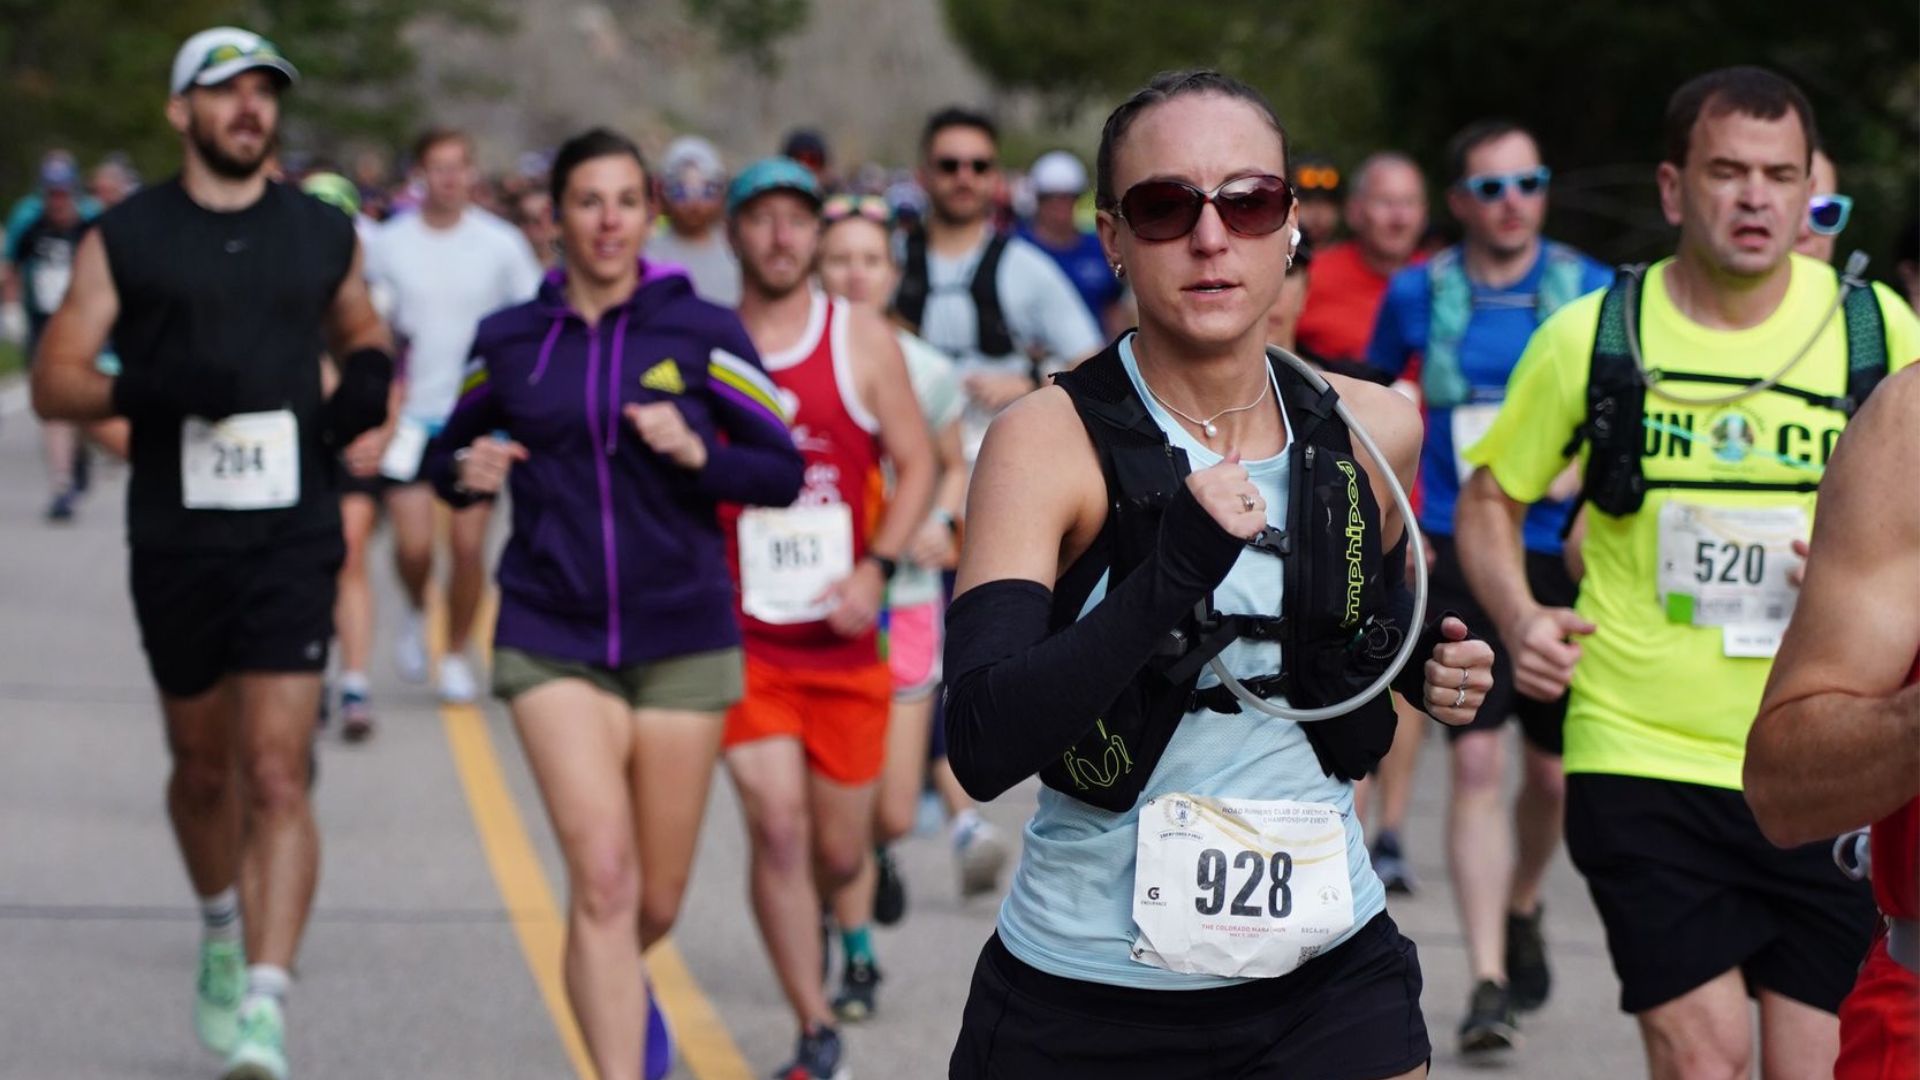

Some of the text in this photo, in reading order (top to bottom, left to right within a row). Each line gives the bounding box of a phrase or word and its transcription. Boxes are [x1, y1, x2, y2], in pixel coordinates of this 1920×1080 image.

[1642, 411, 1693, 457] UN
[211, 442, 264, 478] 204
[1336, 461, 1365, 627] mphipod
[1694, 541, 1765, 584] 520
[1263, 816, 1308, 824] CHAMPIONSHIP
[1302, 808, 1328, 816] AMERICA
[1147, 887, 1160, 900] G
[1195, 848, 1292, 919] 928
[1215, 924, 1251, 932] COLORADO
